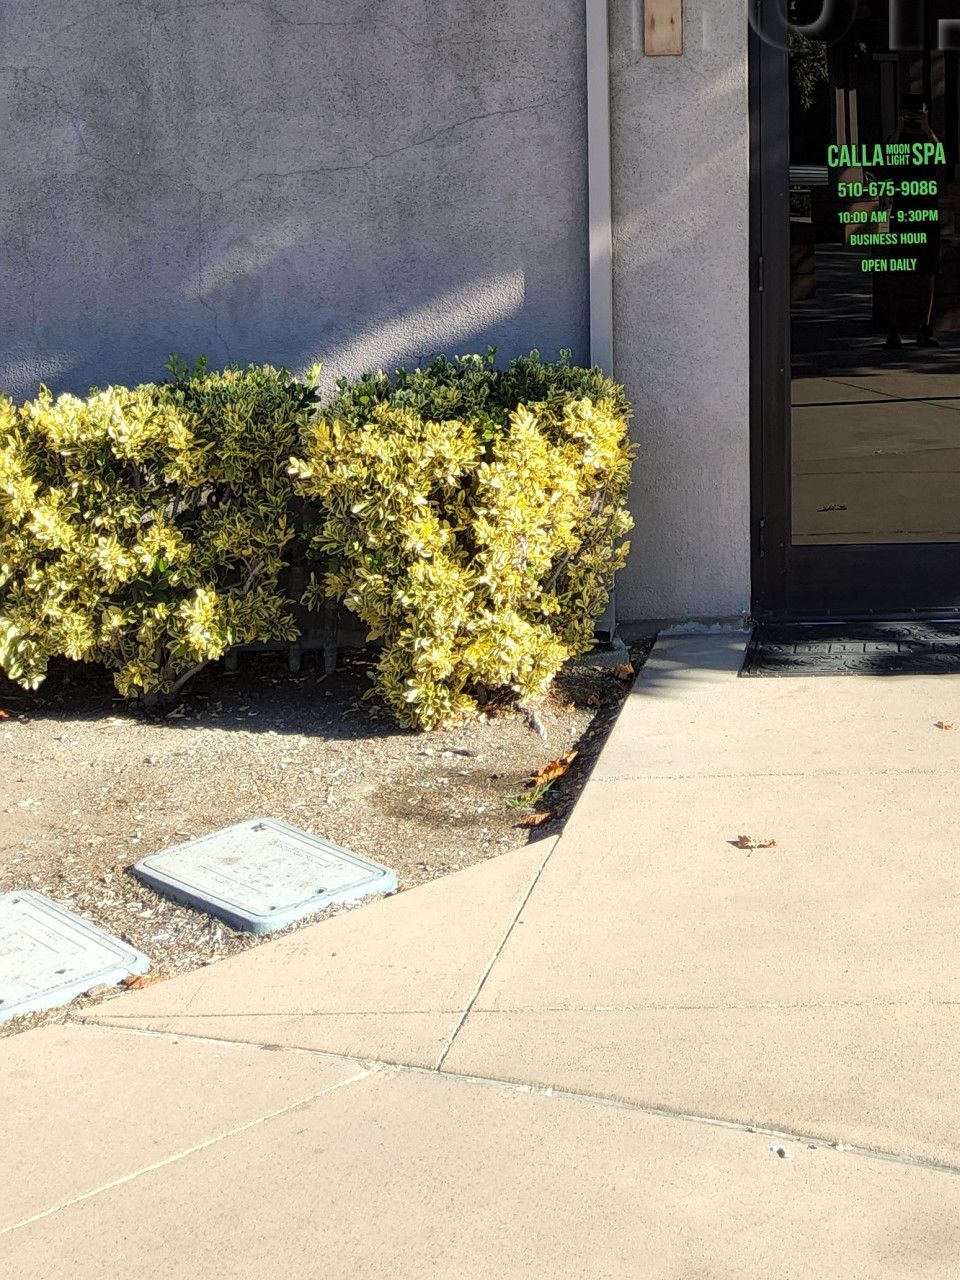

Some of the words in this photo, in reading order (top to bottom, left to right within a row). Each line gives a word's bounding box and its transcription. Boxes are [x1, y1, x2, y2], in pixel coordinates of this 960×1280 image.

[828, 144, 884, 167] CALLA
[886, 144, 910, 154] MOON
[912, 143, 945, 165] SPA
[886, 154, 910, 166] LIGHT
[838, 181, 937, 197] 510-675-9086
[838, 212, 867, 223] 10:00
[871, 211, 886, 222] AM
[898, 210, 938, 222] 9:30PM
[851, 234, 897, 245] BUSINESS
[900, 233, 926, 244] HOUR
[862, 259, 887, 272] OPEN
[890, 259, 916, 271] DAILY
